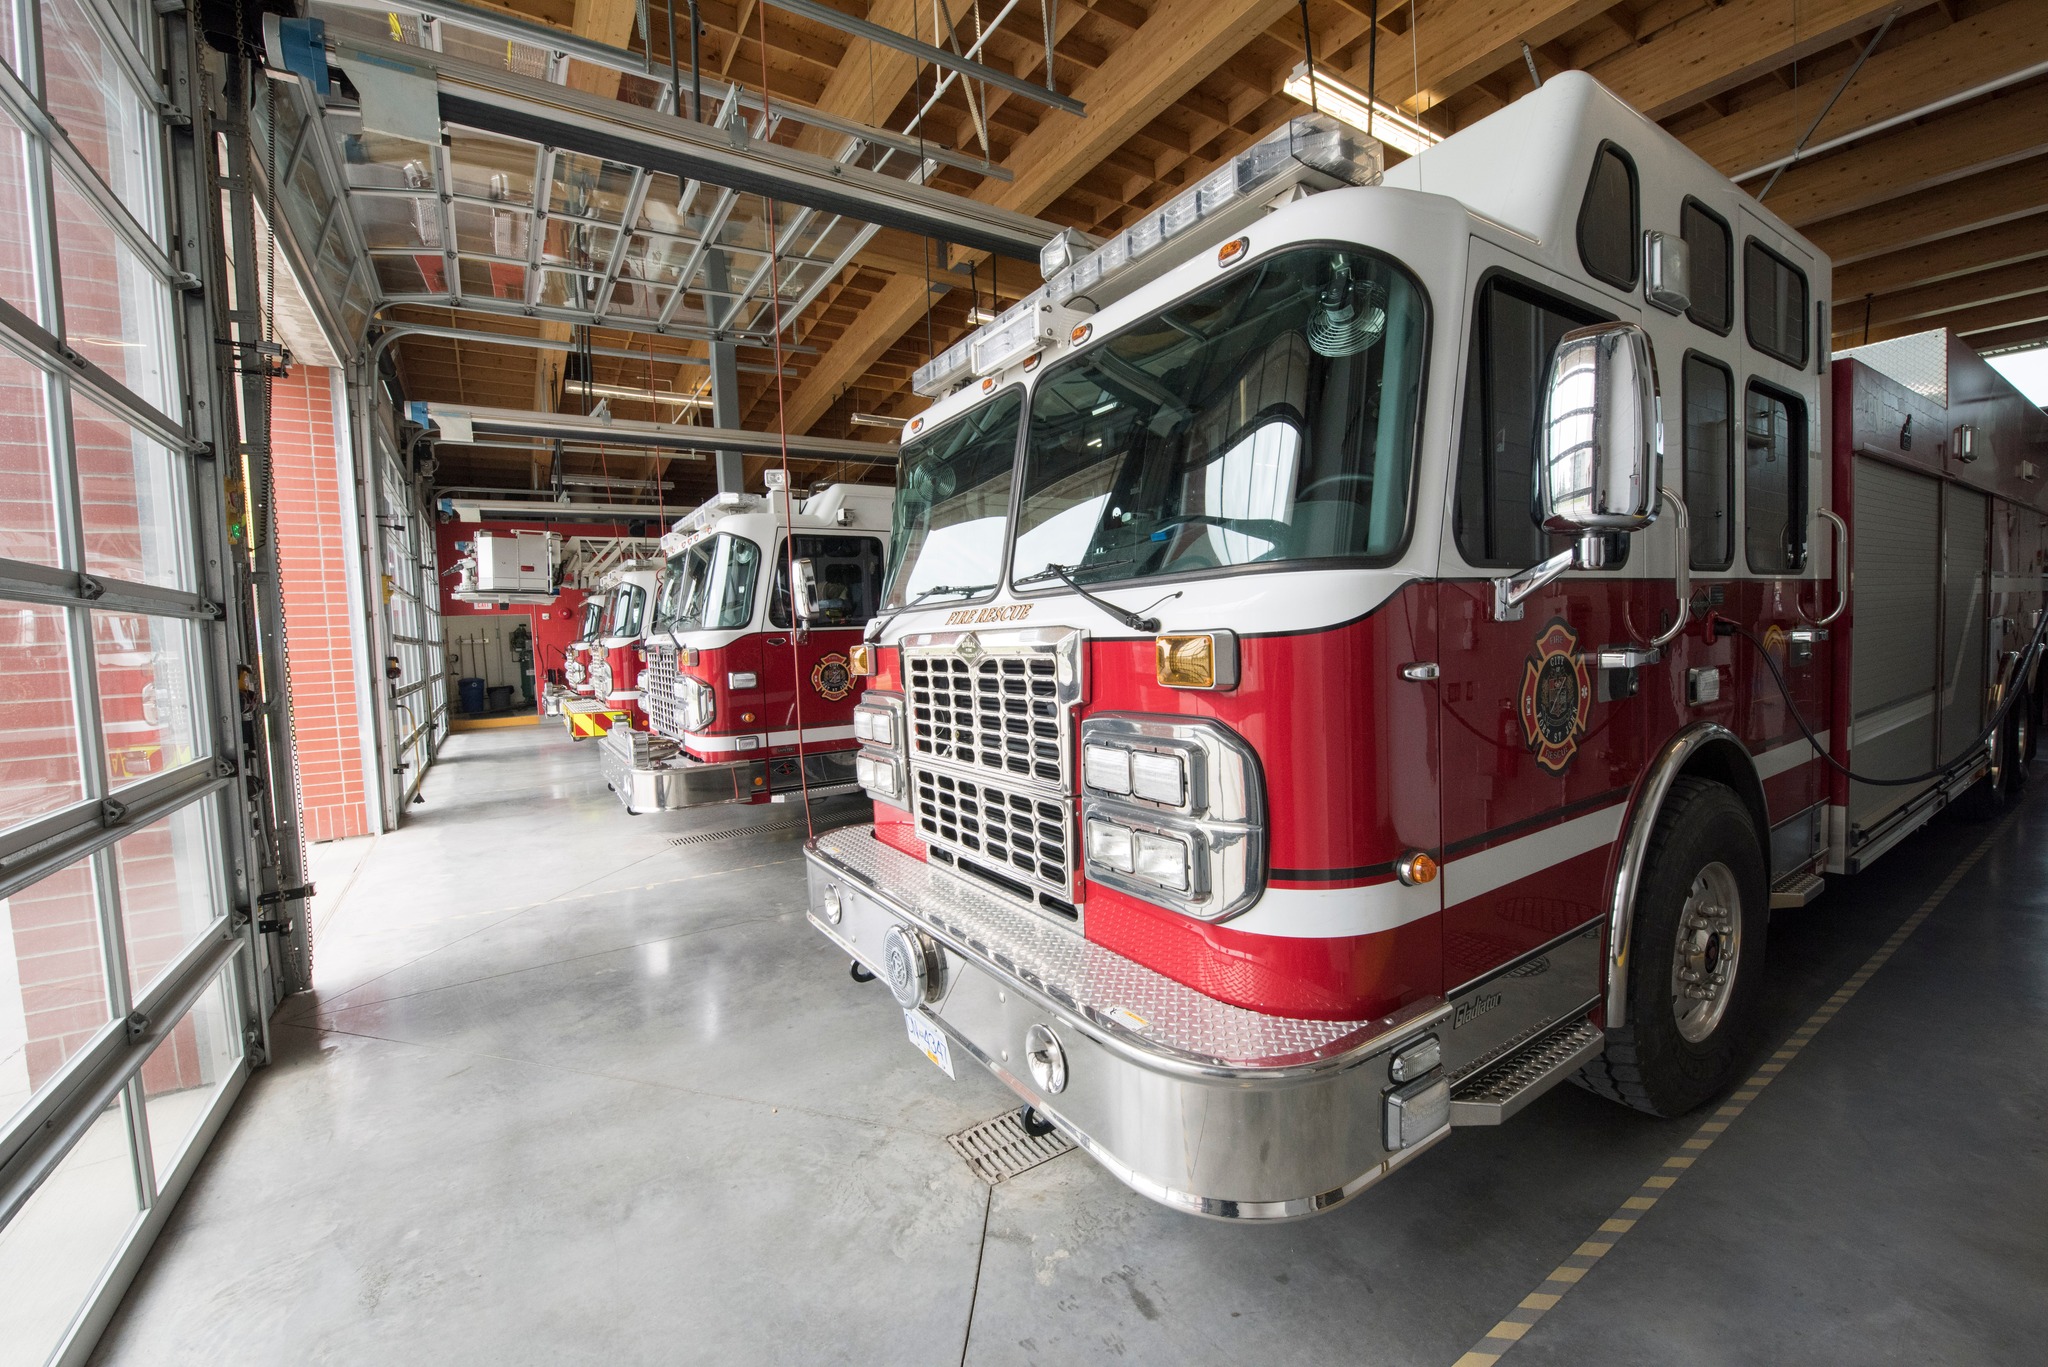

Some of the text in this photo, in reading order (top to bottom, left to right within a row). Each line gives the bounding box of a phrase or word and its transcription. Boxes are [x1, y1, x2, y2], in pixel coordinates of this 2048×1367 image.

[945, 603, 1034, 625] FIRE RESCUE
[1549, 635, 1564, 645] FIRE
[1550, 655, 1565, 667] CITY
[1536, 706, 1578, 743] FORT ST JOHN
[1545, 745, 1569, 760] RESCUE
[1453, 992, 1502, 1030] Gladiator
